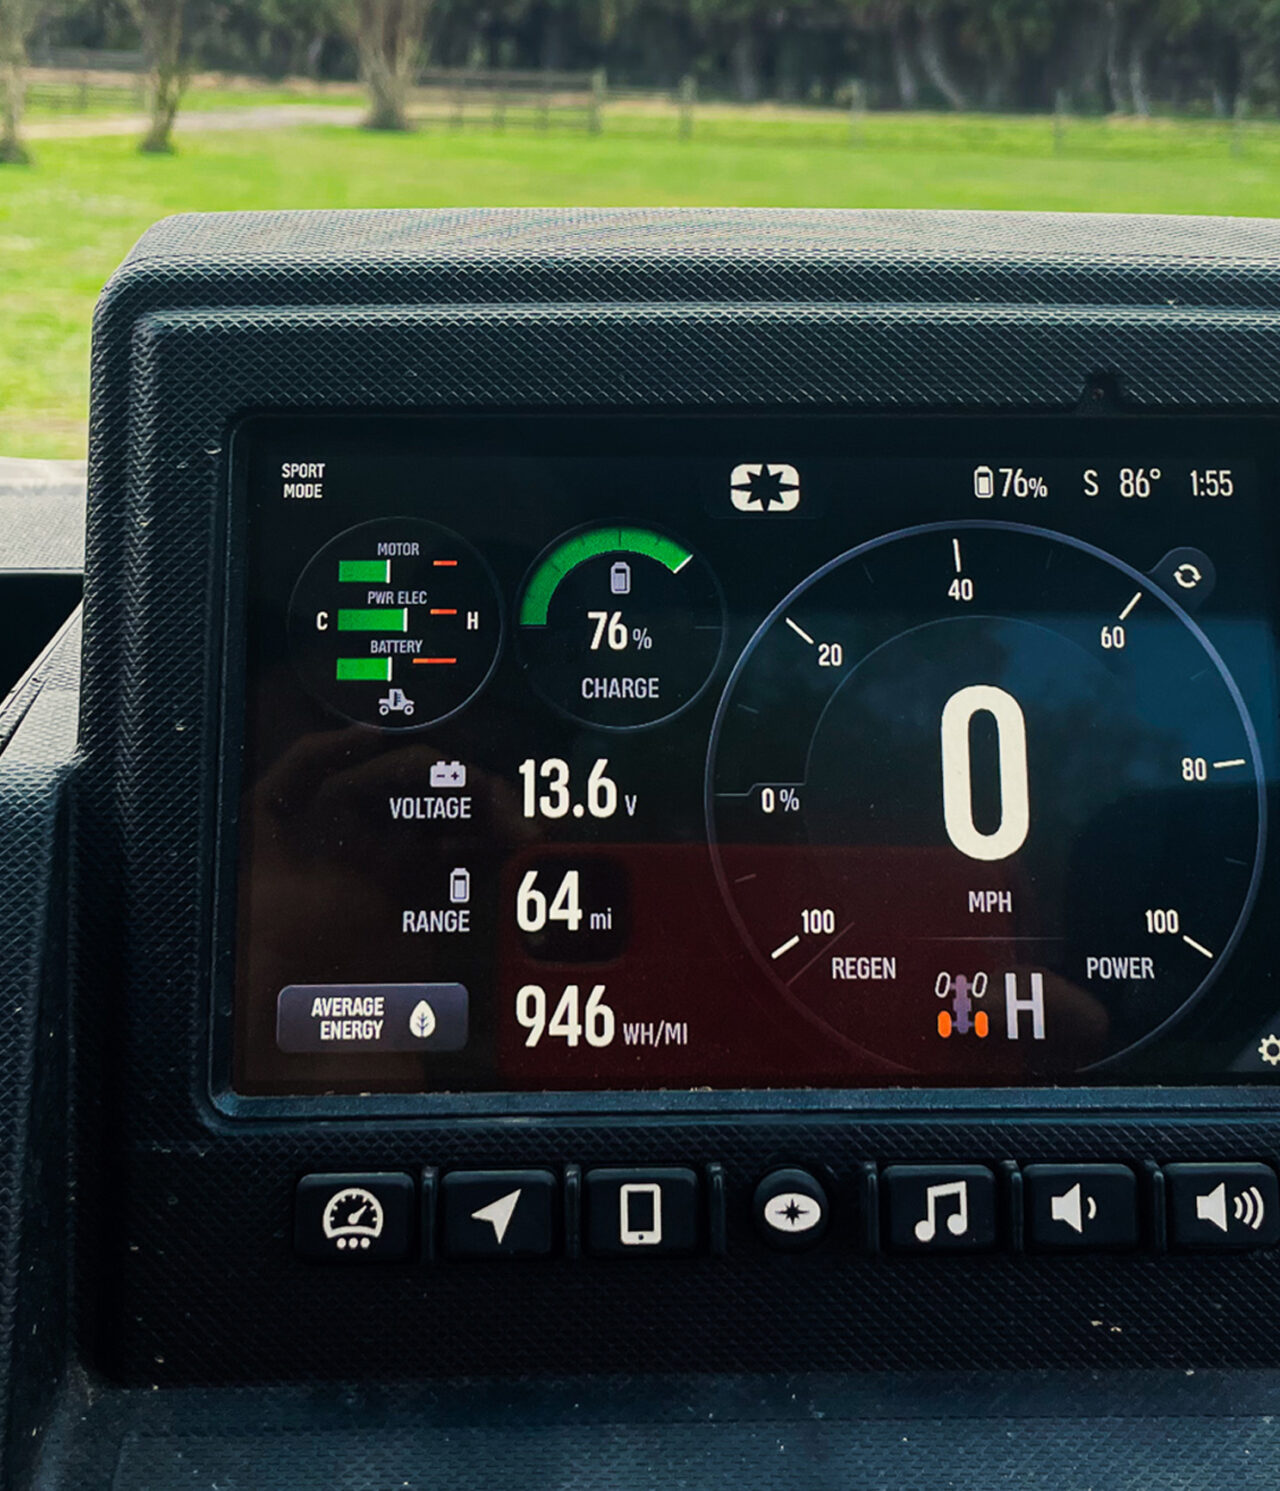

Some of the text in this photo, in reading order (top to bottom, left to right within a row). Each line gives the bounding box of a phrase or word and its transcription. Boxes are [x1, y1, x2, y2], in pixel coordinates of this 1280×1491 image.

[281, 462, 326, 479] SPORT
[283, 483, 323, 499] MODE
[998, 468, 1048, 498] 76%
[1083, 468, 1161, 498] S 86°
[1190, 469, 1234, 497] 1:55
[377, 542, 420, 556] MOTOR
[367, 590, 428, 605] PWR ELEC
[947, 578, 974, 601] 40
[316, 611, 329, 631] C
[466, 611, 479, 630] H
[587, 611, 628, 650] 76
[370, 639, 423, 654] BATTERY
[1100, 625, 1125, 649] 60
[818, 643, 842, 667] 20
[581, 677, 660, 699] CHARGE
[940, 684, 1030, 861] 0
[1181, 757, 1207, 781] 80
[518, 757, 637, 819] 13.6 V
[389, 796, 472, 819] VOLTAGE
[516, 870, 612, 932] 64 mi
[968, 890, 1012, 913] MPH
[402, 909, 471, 933] RANGE
[801, 908, 835, 934] 100
[1145, 909, 1179, 934] 100
[831, 956, 896, 980] REGEN
[1086, 956, 1155, 980] POWER
[311, 996, 385, 1017] AVERAGE
[515, 984, 688, 1048] 946 WH/MI
[1004, 972, 1046, 1040] H
[320, 1019, 384, 1040] ENERGY
